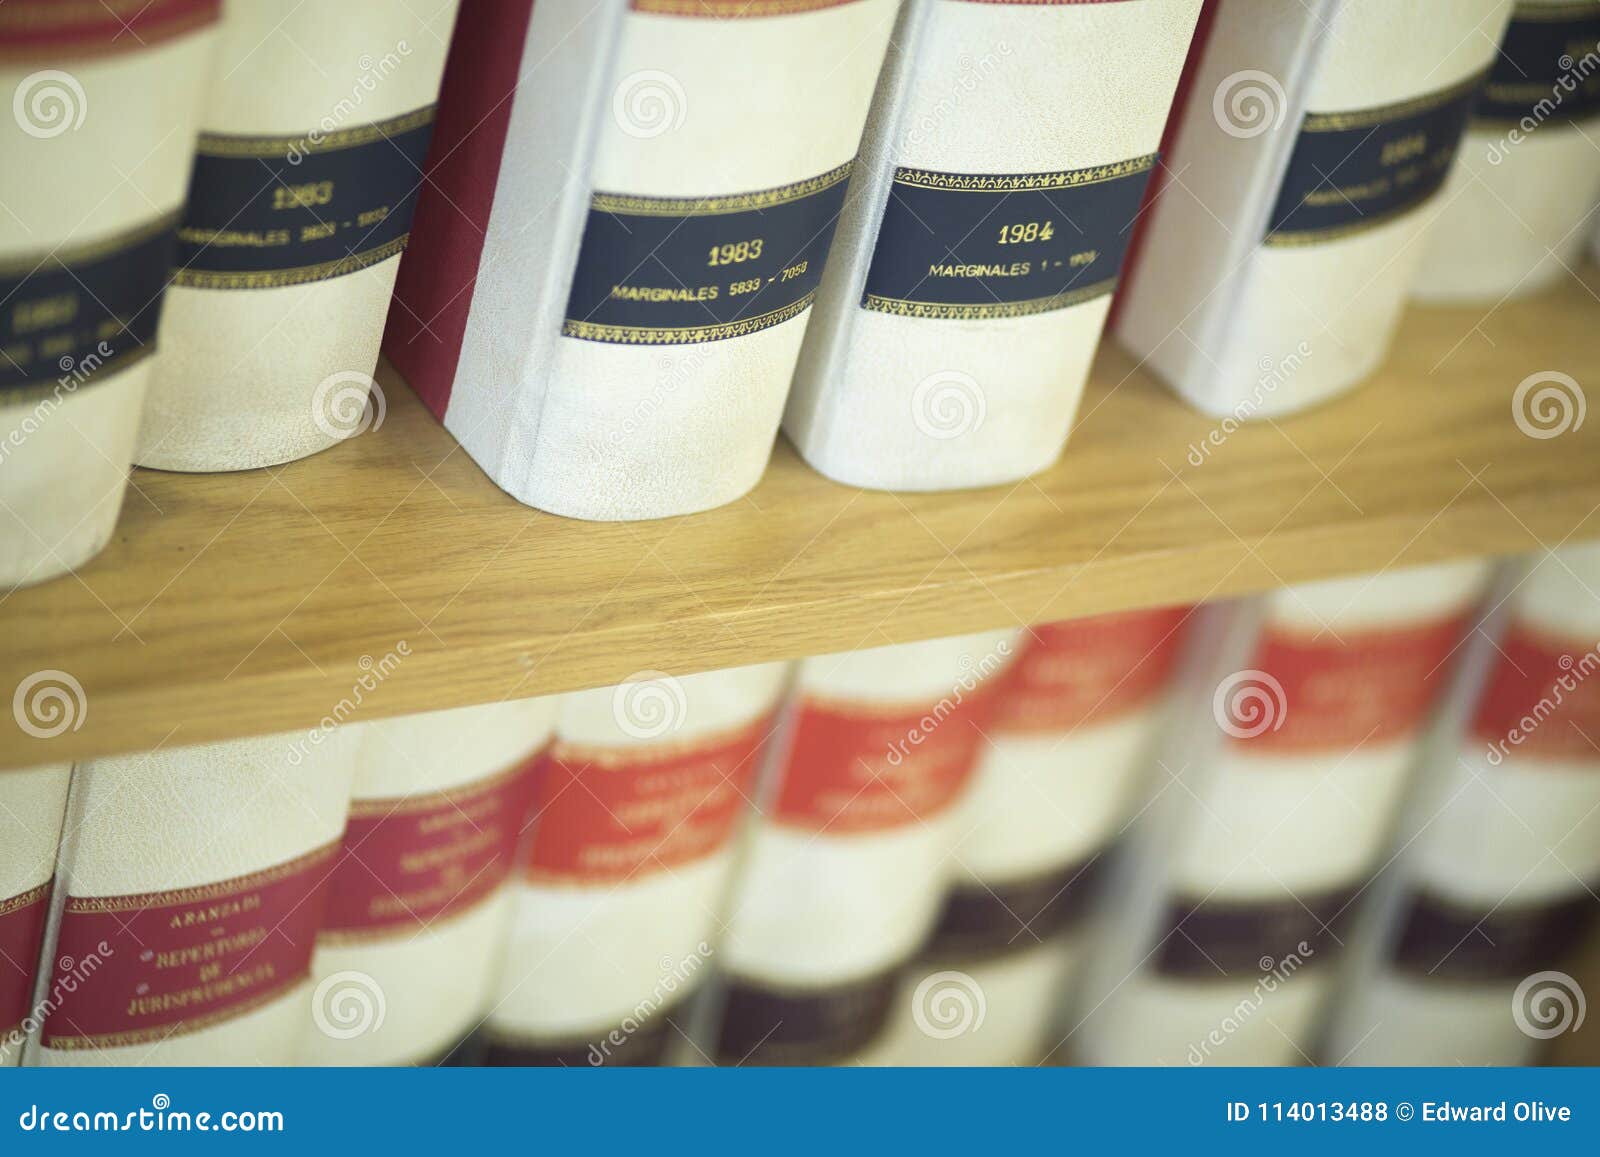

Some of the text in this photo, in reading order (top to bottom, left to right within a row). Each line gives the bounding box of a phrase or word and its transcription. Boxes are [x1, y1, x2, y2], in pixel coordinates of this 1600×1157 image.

[997, 221, 1055, 245] 1984
[707, 239, 764, 267] 1983
[928, 261, 1031, 278] MARGINALES
[609, 285, 720, 303] MARGINALES
[728, 277, 761, 296] 5833
